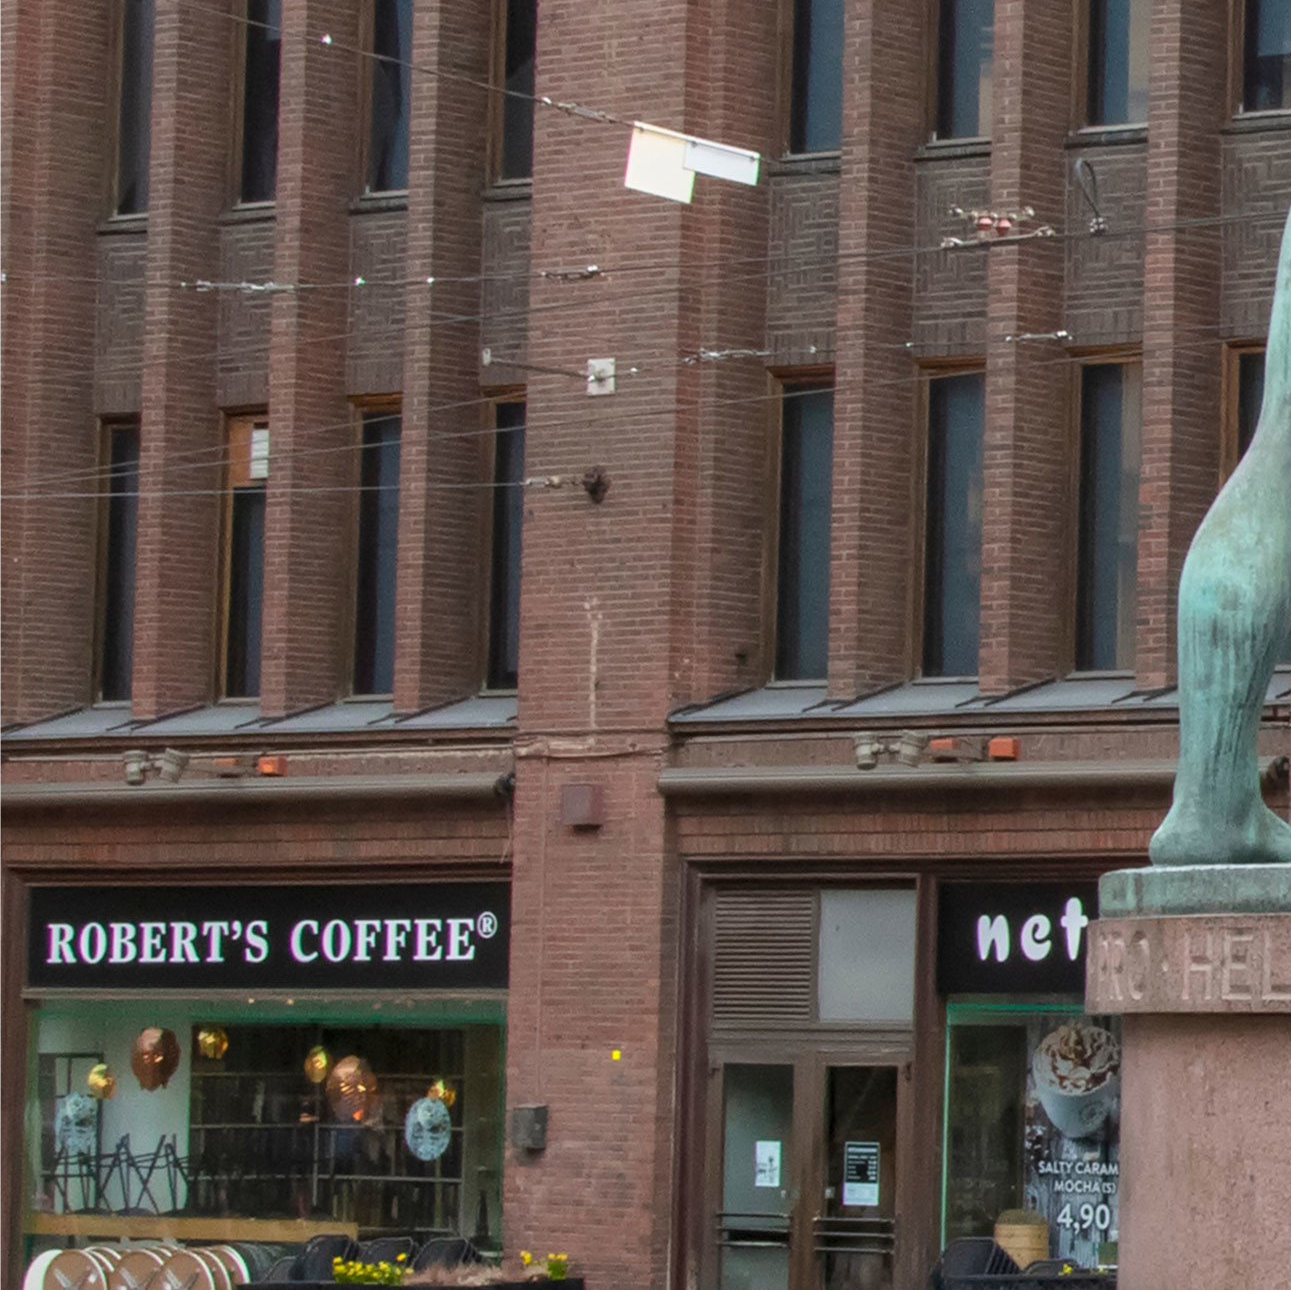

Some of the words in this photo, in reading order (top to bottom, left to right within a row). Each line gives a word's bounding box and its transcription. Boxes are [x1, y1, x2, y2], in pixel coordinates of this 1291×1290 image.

[46, 919, 270, 964] ROBERT'S
[976, 895, 1089, 962] net
[1037, 1160, 1074, 1175] SALTY
[1053, 1179, 1101, 1193] MOCHA
[1056, 1202, 1111, 1235] 4,90
